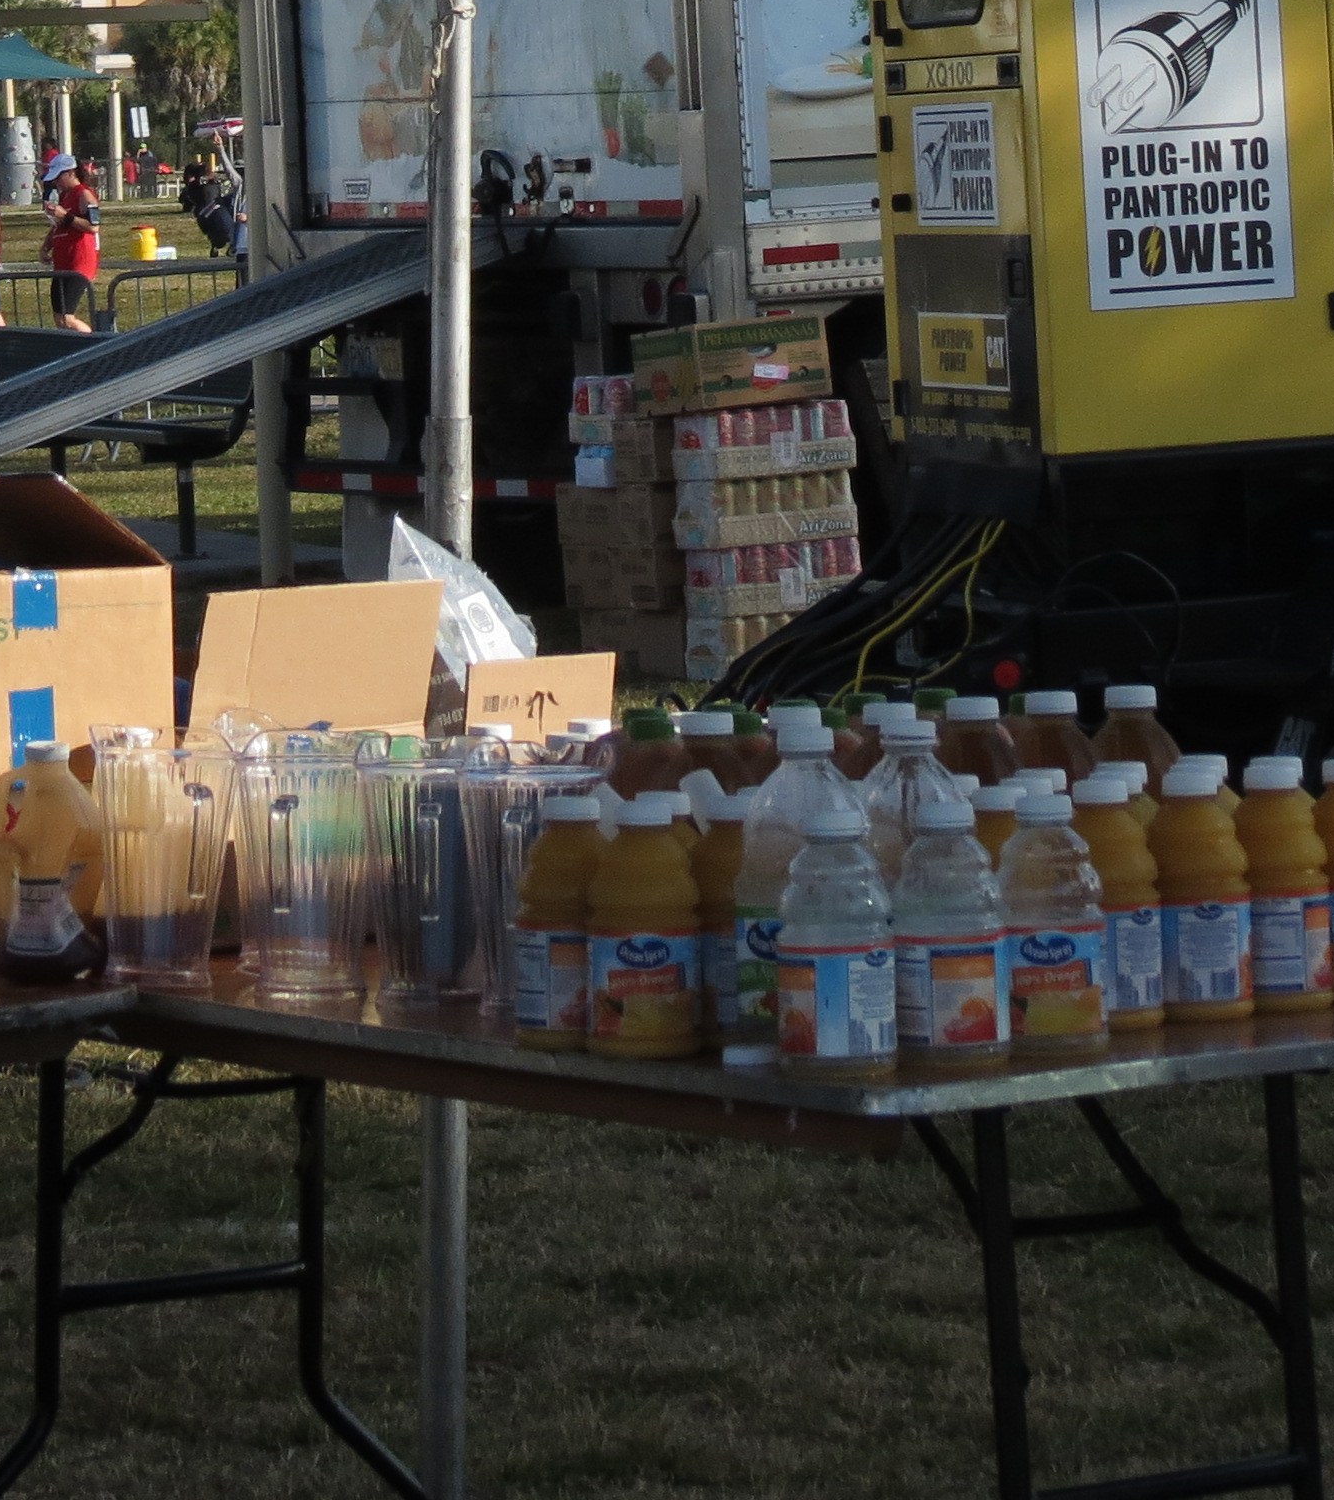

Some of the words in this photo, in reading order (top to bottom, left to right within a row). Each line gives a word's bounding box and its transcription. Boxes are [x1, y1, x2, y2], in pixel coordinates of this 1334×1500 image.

[926, 61, 974, 89] XQ100
[1101, 139, 1223, 179] PLUG-IN
[1230, 136, 1270, 171] TO
[952, 175, 994, 211] POWER
[1104, 178, 1271, 220] PANTROPIC
[1107, 220, 1275, 280] POWER
